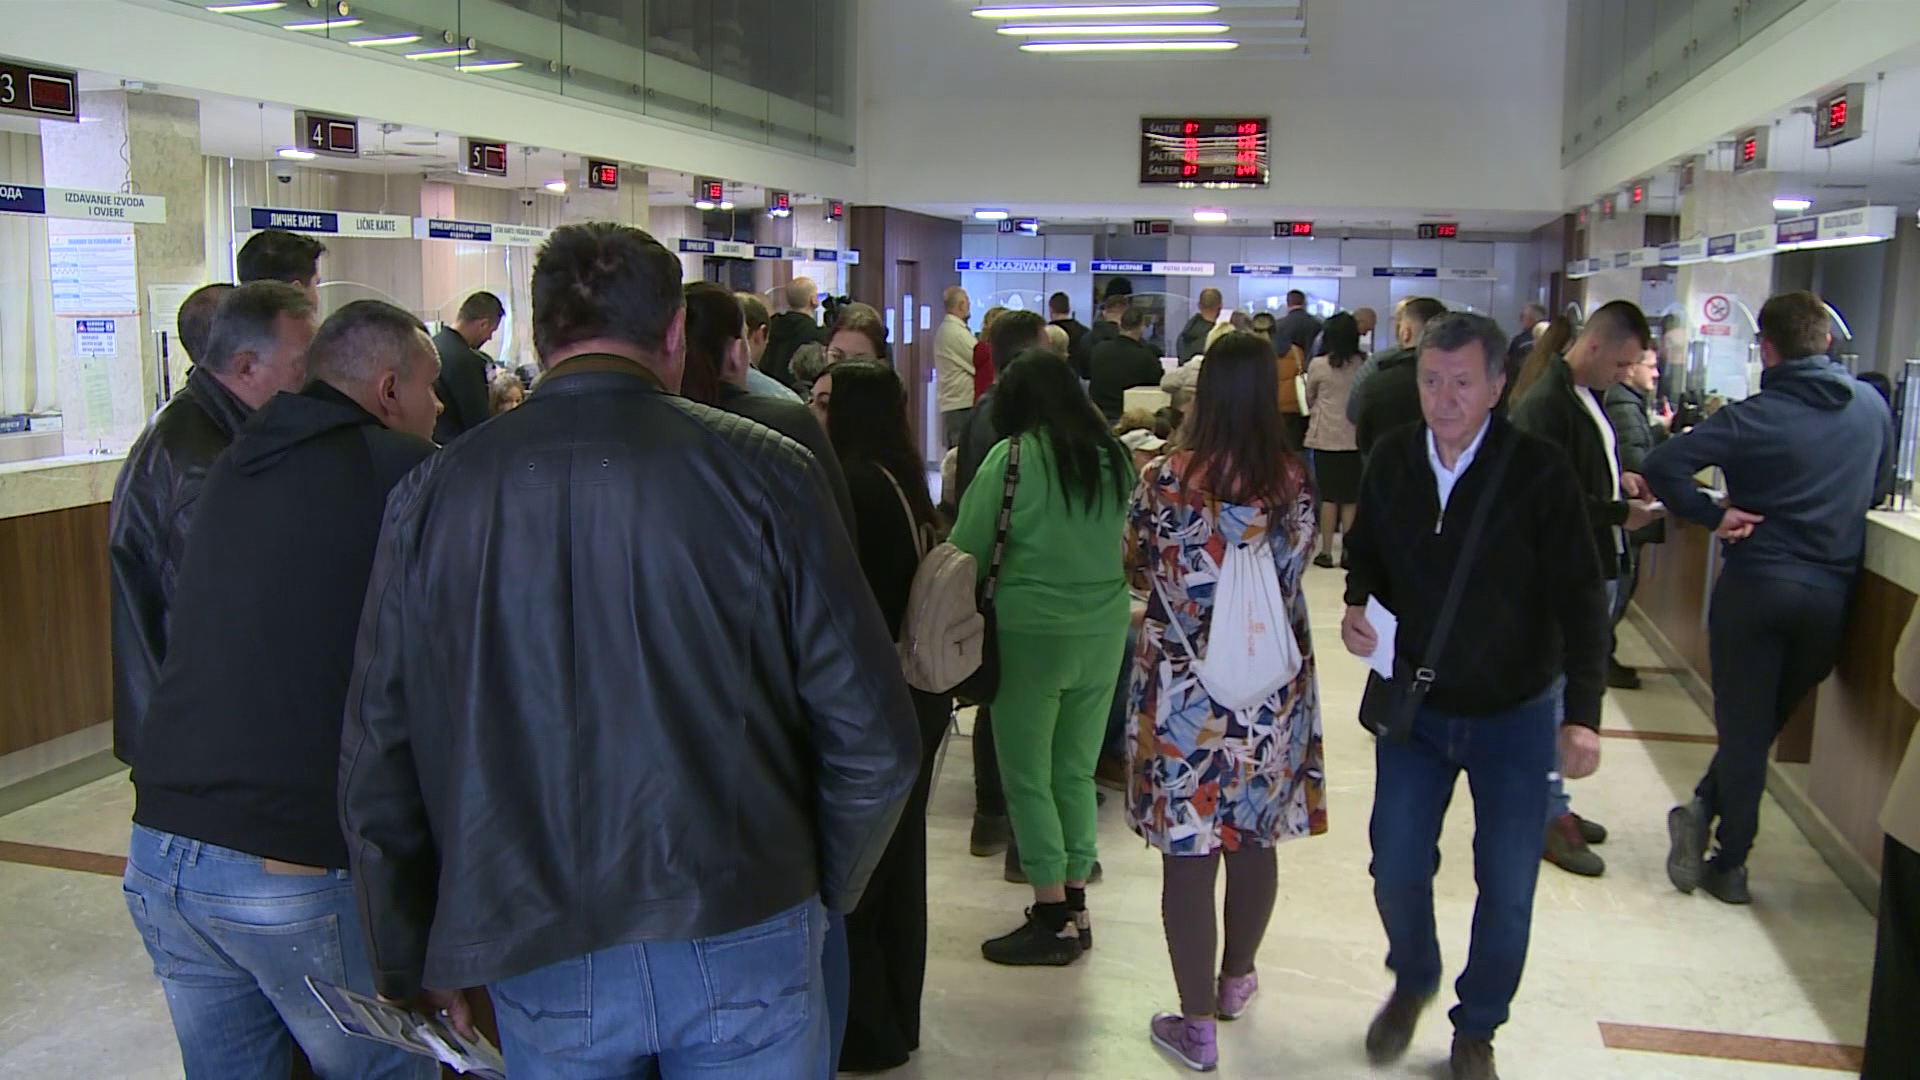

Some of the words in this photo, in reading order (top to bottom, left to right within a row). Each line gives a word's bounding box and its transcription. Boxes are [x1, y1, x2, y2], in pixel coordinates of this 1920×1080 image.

[0, 73, 16, 103] 3
[312, 123, 323, 146] 4
[473, 146, 481, 167] 5
[592, 165, 599, 184] 6
[65, 192, 112, 206] IZDAVANJE
[113, 197, 145, 207] IZVODA
[88, 206, 92, 215] I
[94, 206, 125, 217] OVJERE
[270, 212, 297, 228] ЛИЧНЕ
[298, 214, 322, 228] КАРТЕ
[356, 216, 375, 231] LIČNE
[376, 219, 396, 232] KARTE
[999, 221, 1011, 231] 10
